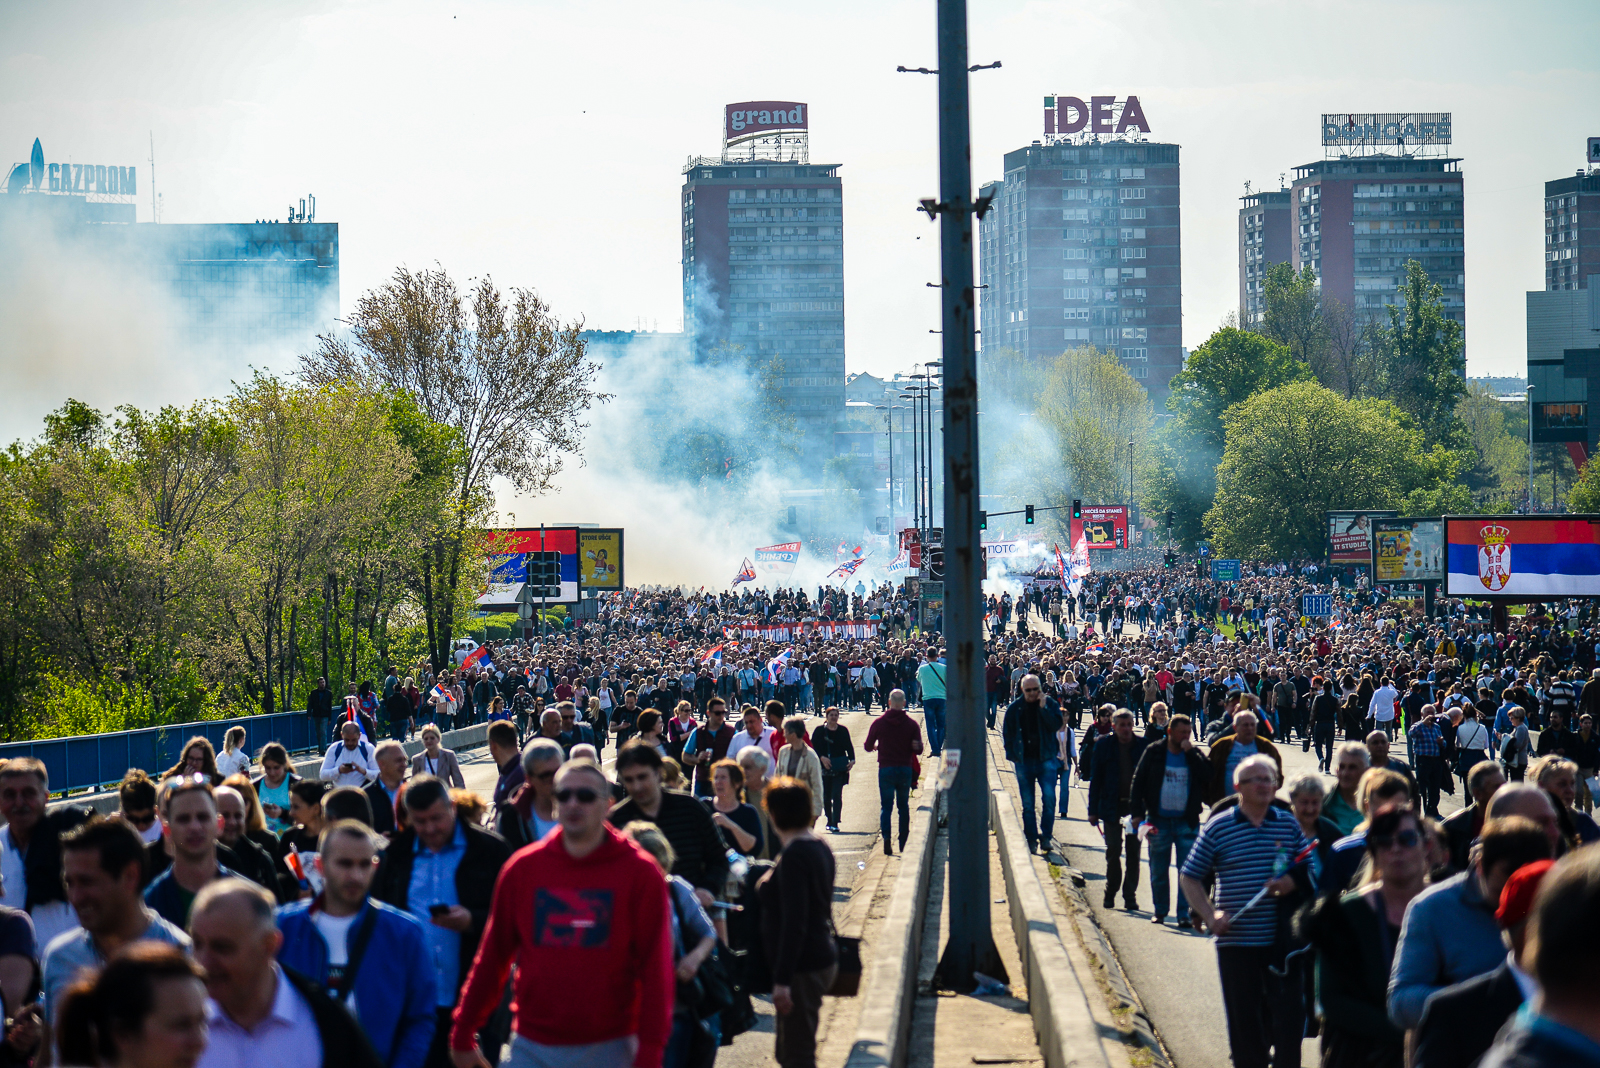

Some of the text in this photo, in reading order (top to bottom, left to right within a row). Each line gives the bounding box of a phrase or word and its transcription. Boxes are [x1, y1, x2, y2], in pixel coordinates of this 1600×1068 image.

[731, 104, 803, 131] grand
[48, 162, 137, 195] GAZPROM
[1341, 541, 1367, 549] STUDIJE
[834, 624, 878, 639] ВУЧИЋА
